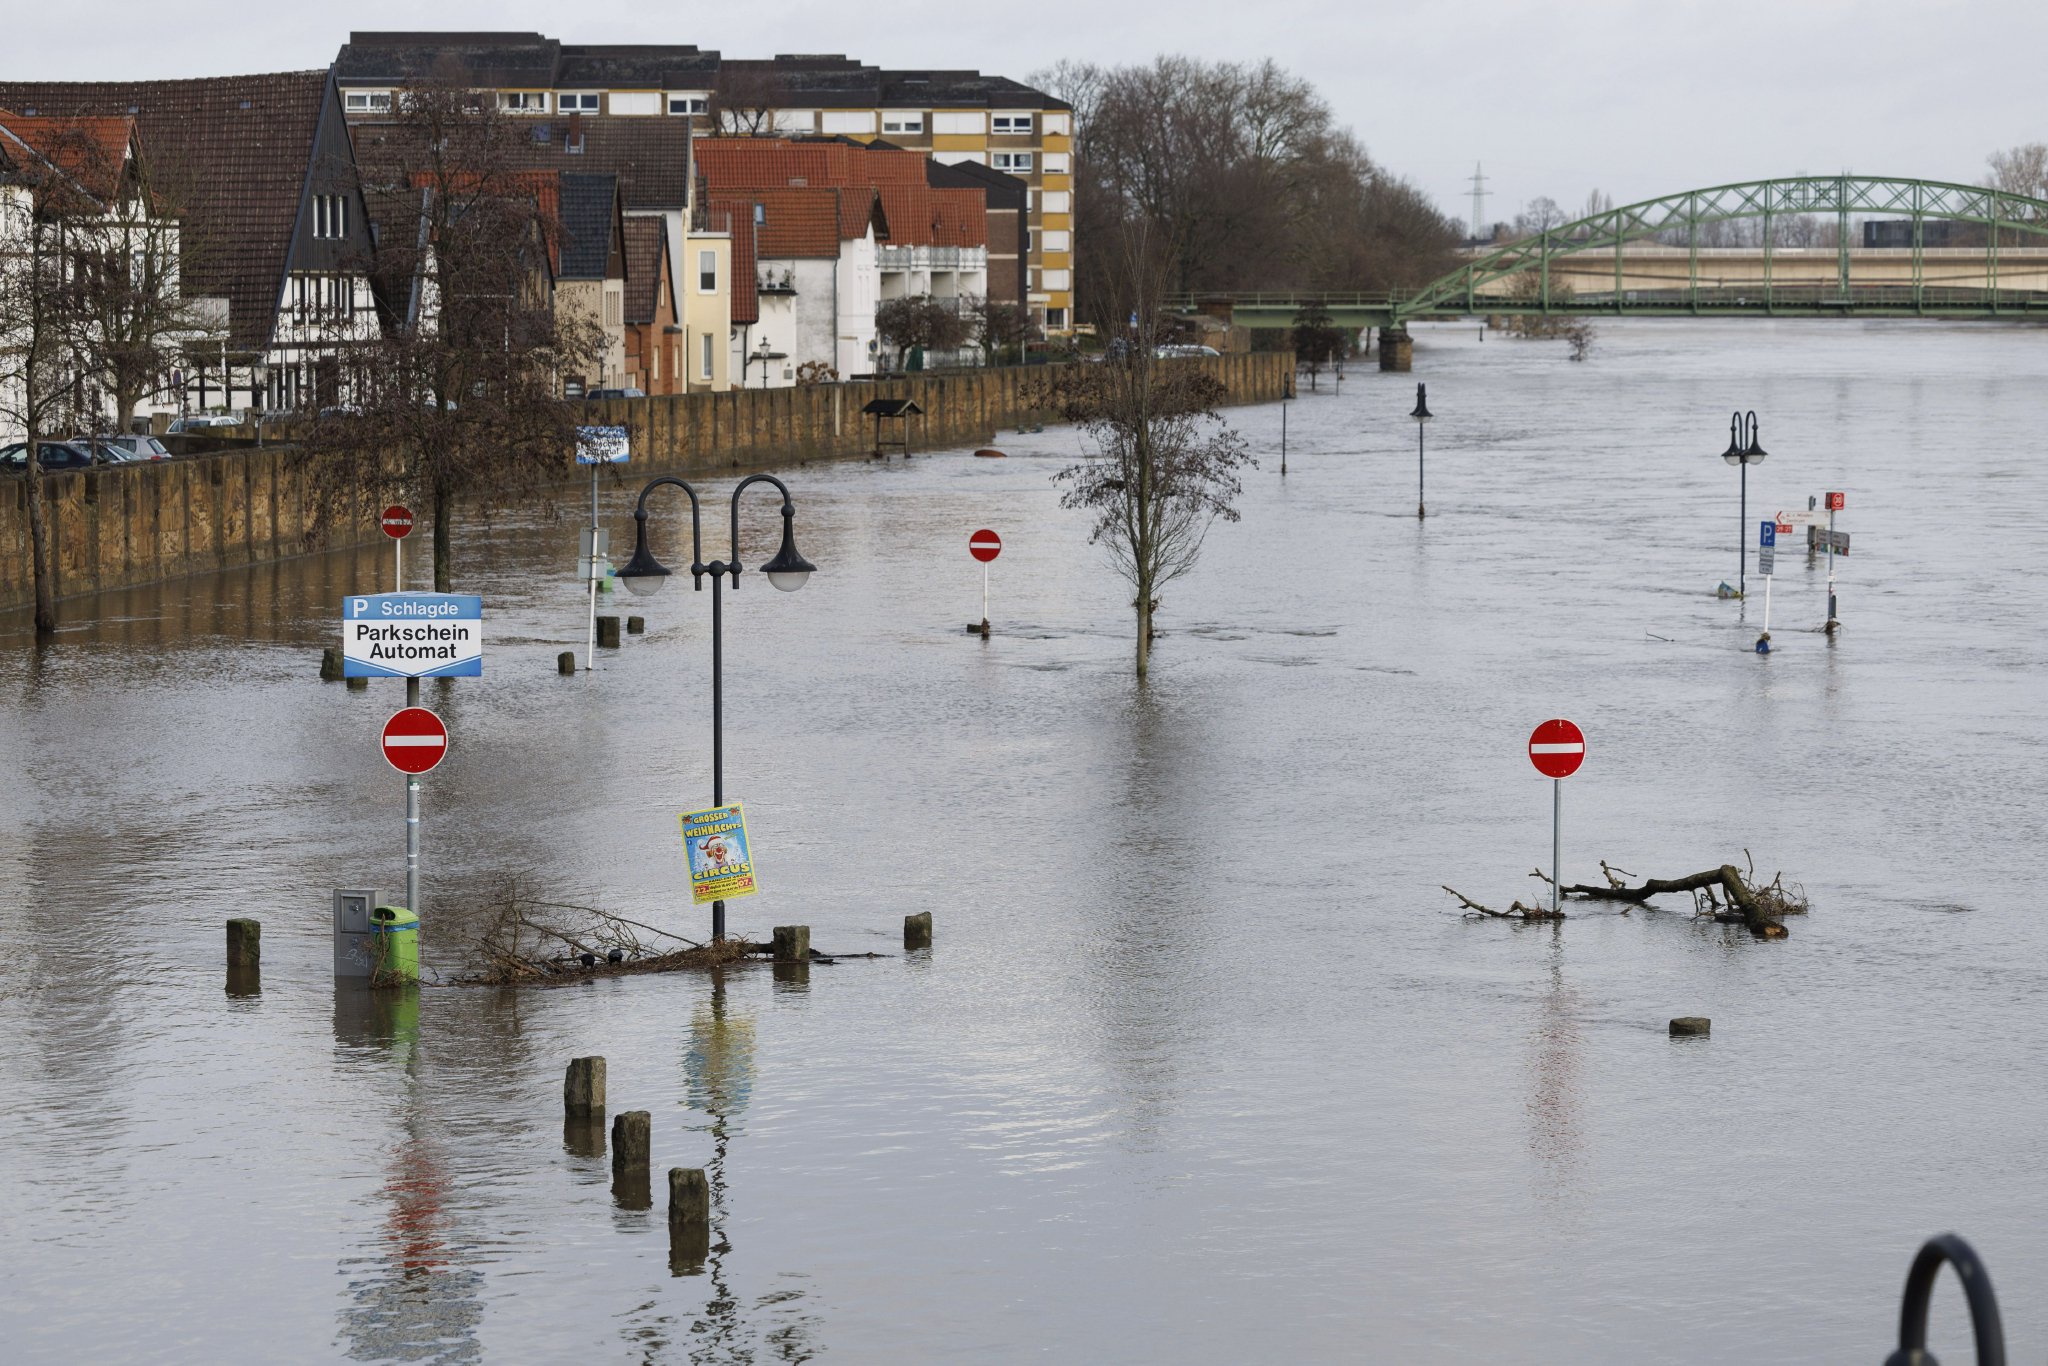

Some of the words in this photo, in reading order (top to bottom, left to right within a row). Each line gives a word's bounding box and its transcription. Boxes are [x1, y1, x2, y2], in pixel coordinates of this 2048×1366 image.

[1764, 525, 1772, 543] P
[353, 599, 369, 618] P
[381, 601, 459, 618] Schlagde
[357, 624, 469, 641] Parkschein
[370, 643, 457, 659] Automat
[693, 812, 729, 824] GROSSER
[693, 863, 750, 880] CIRCUS
